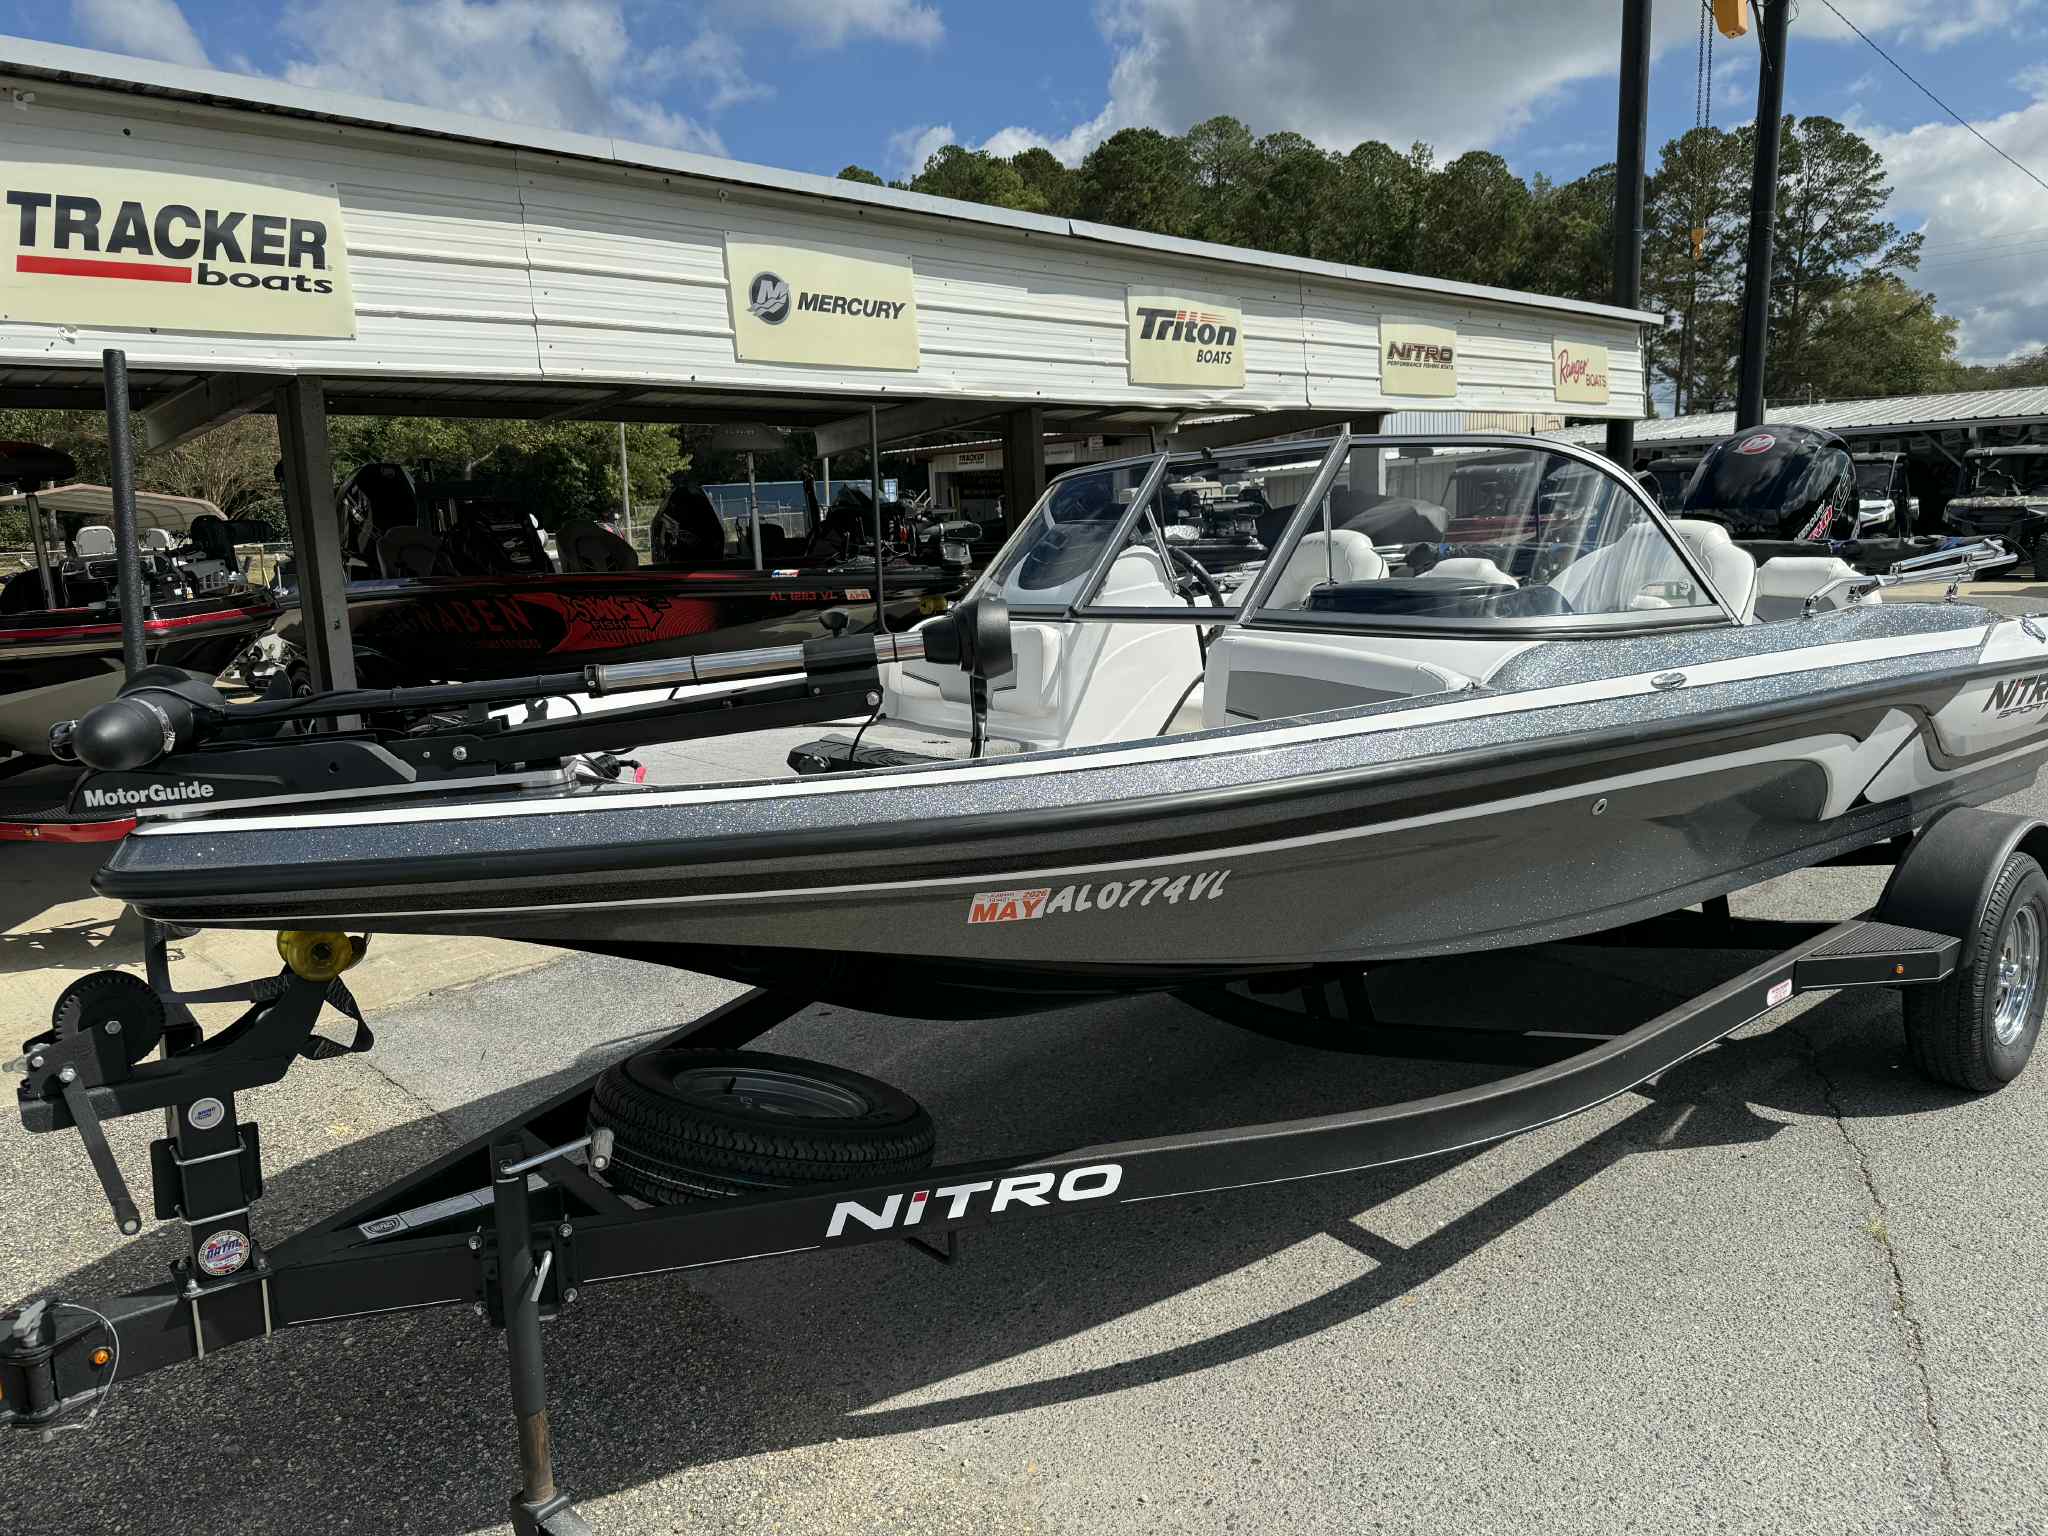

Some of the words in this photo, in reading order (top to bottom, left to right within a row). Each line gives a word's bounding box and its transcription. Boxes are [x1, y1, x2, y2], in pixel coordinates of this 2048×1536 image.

[6, 190, 327, 270] TRACKER
[197, 262, 333, 294] boats
[797, 292, 906, 319] MERCURY
[1136, 307, 1237, 346] Triton
[1196, 350, 1232, 364] BOATS
[1387, 341, 1453, 363] NITRO
[1558, 349, 1590, 384] Ranger
[1586, 374, 1607, 388] BOATS
[1980, 673, 2048, 713] NITR
[83, 781, 214, 807] MotorGuide
[971, 899, 1042, 922] MAY
[825, 1164, 1123, 1238] NITRO
